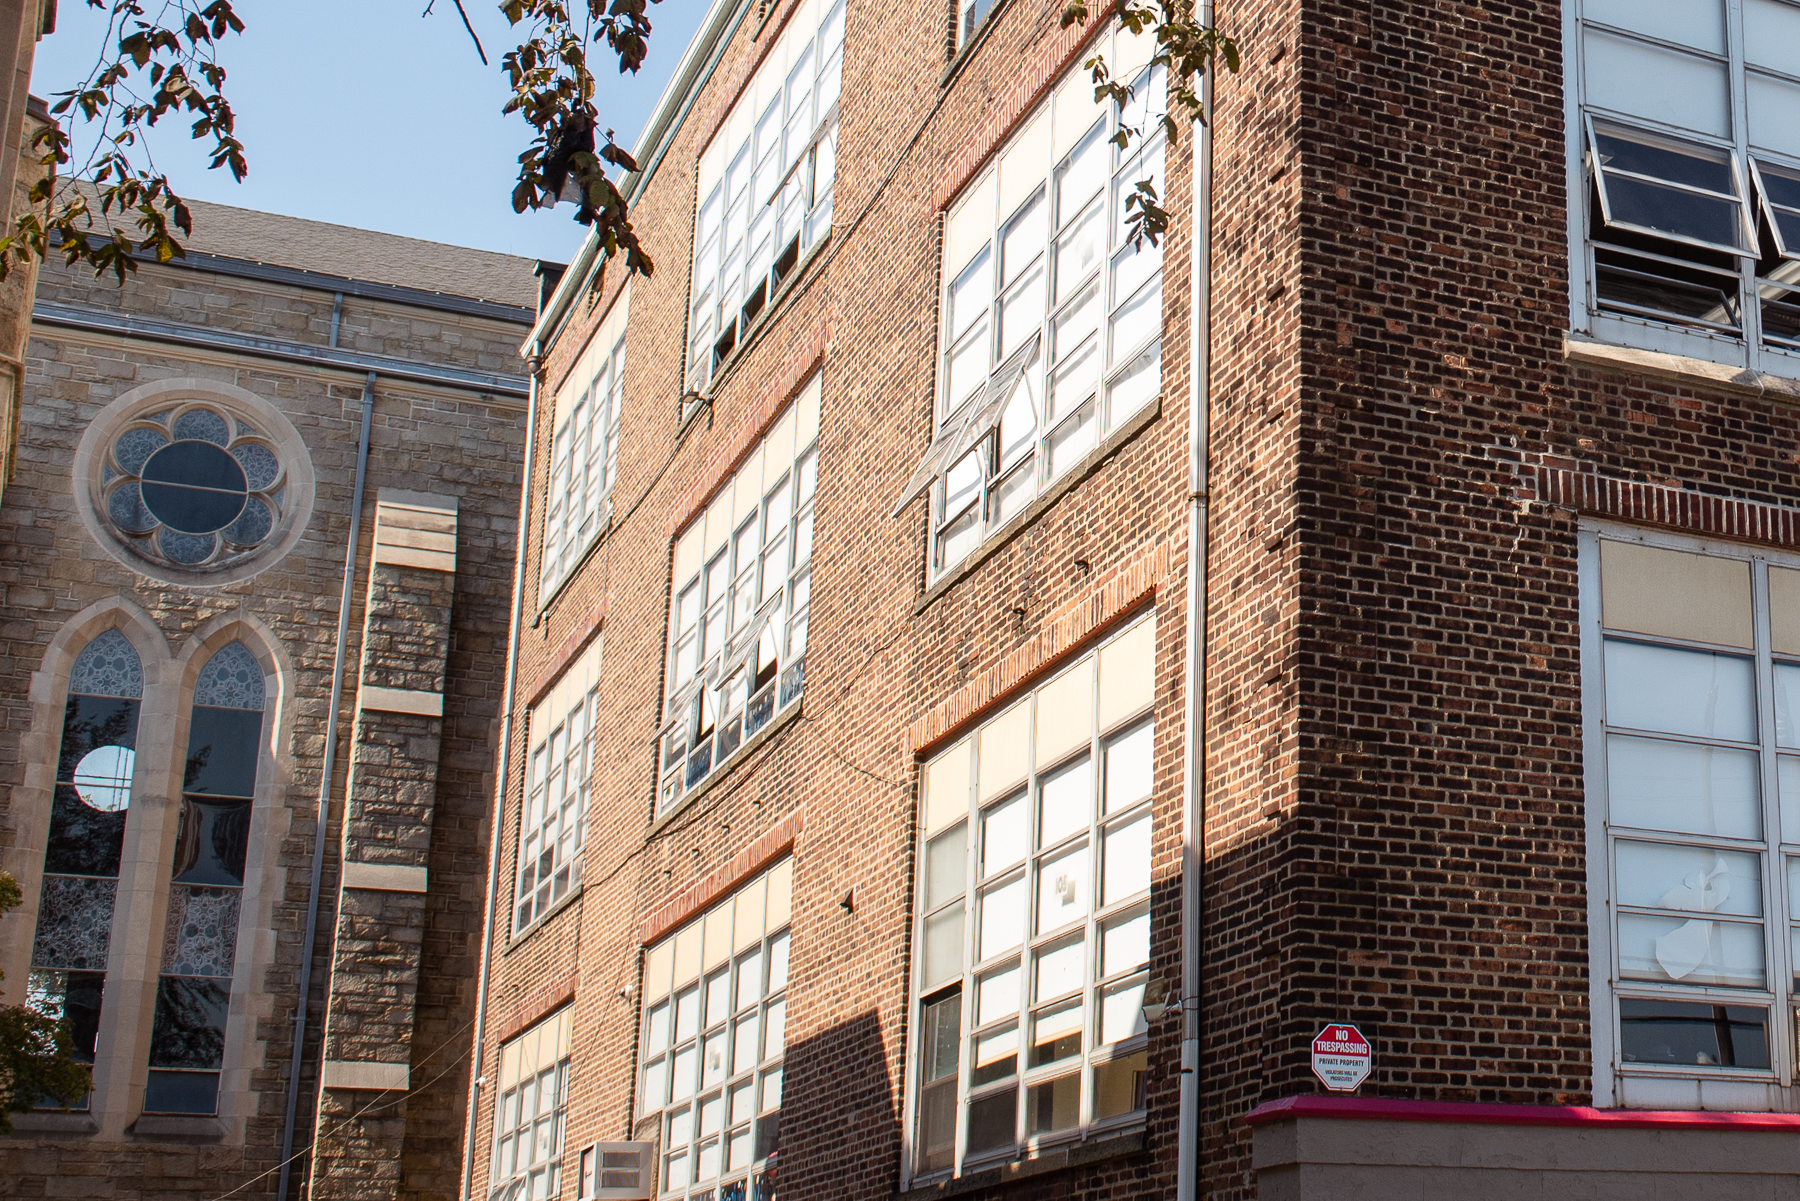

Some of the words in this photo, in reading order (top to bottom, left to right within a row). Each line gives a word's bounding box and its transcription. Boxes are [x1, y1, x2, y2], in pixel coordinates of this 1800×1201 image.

[1336, 1030, 1348, 1040] NO
[1316, 1041, 1367, 1054] TRESPASSING
[1319, 1058, 1338, 1066] PRIVATE
[1339, 1059, 1364, 1067] PROPERTY
